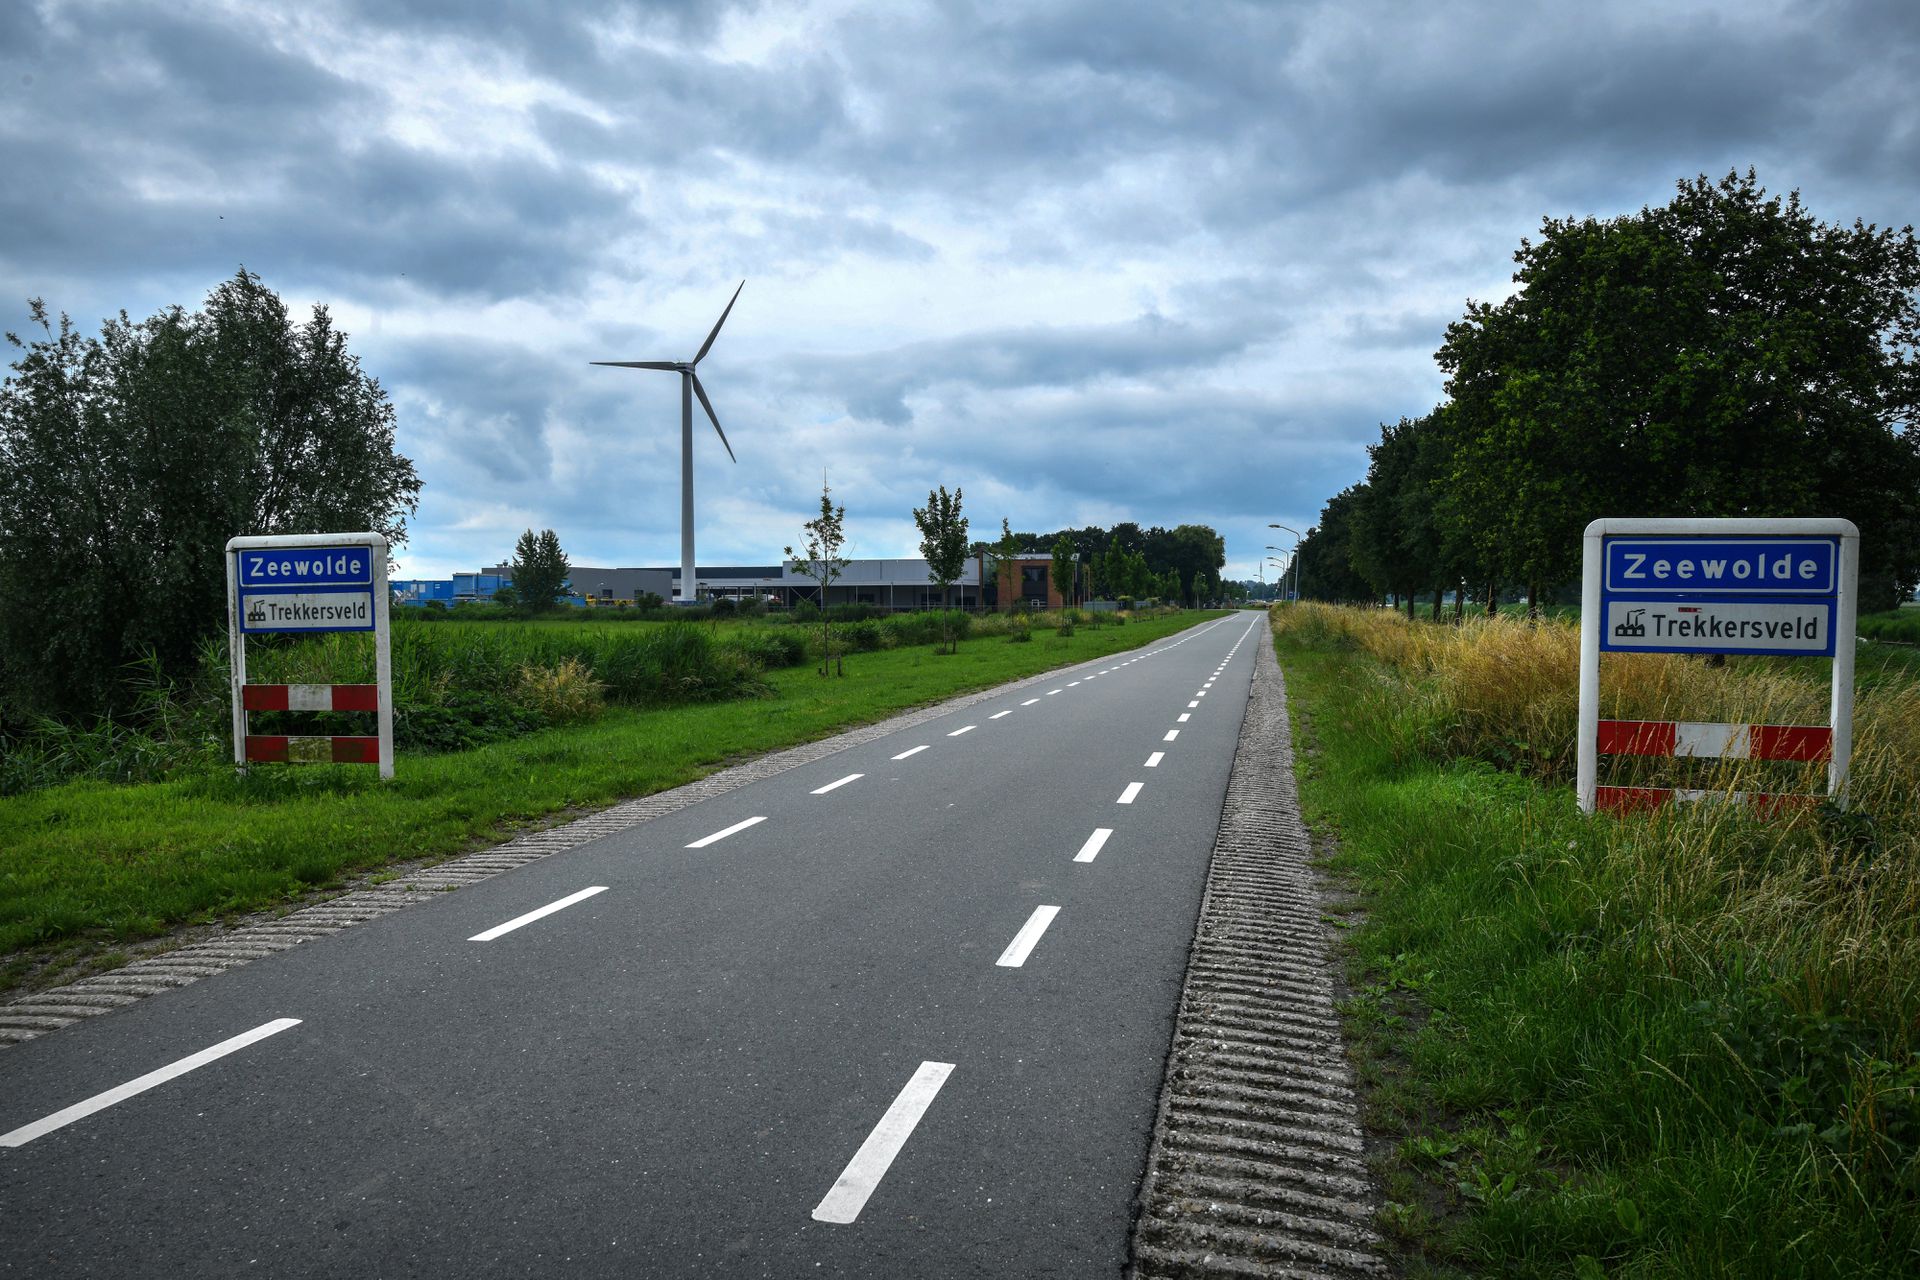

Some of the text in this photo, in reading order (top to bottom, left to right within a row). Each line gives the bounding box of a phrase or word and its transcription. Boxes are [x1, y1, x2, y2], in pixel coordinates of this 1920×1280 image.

[249, 555, 361, 577] Zeewolde
[1623, 553, 1818, 579] Zeewolde
[269, 602, 365, 621] Trekkersveld
[1652, 614, 1817, 640] Trekkersveld
